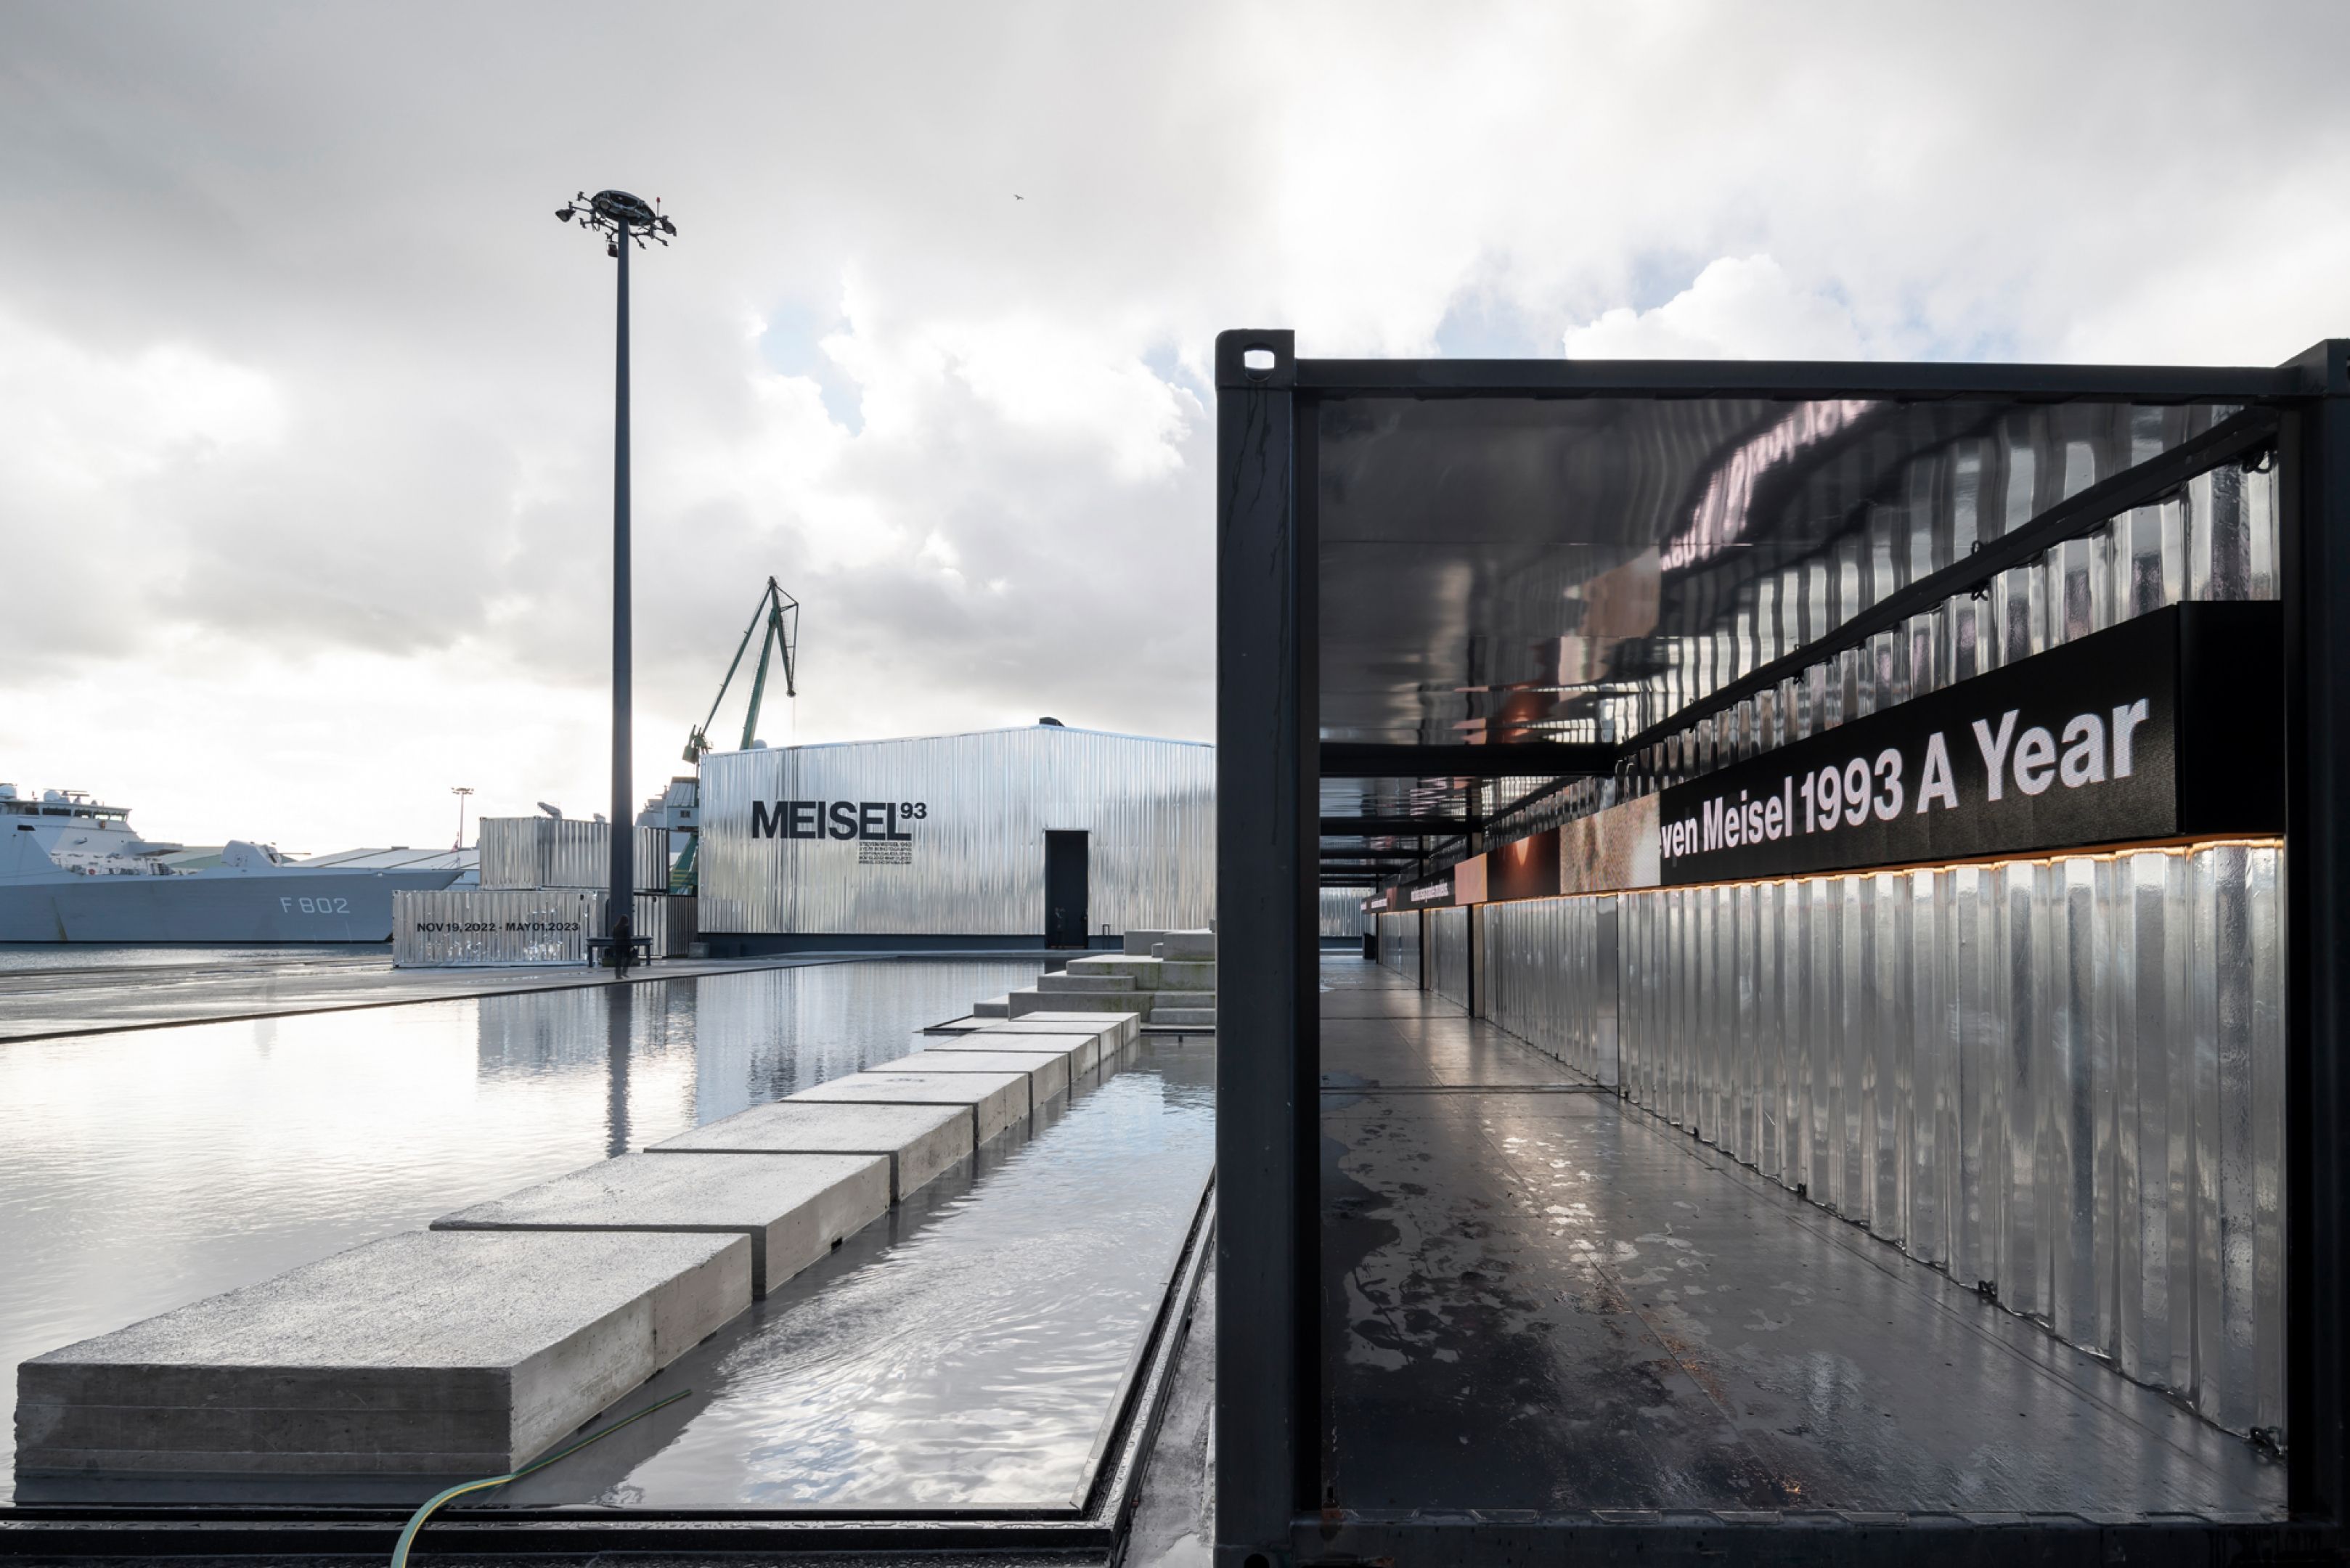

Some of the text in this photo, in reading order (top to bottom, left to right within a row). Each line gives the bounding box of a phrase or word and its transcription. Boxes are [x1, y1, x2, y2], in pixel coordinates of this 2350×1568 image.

[1660, 698, 2150, 859] ven Meisel 1993 A Year
[752, 800, 912, 841] MEISEL
[298, 897, 350, 913] 802
[417, 923, 444, 932] NOV
[465, 923, 495, 932] 2022
[506, 923, 531, 931] MAY
